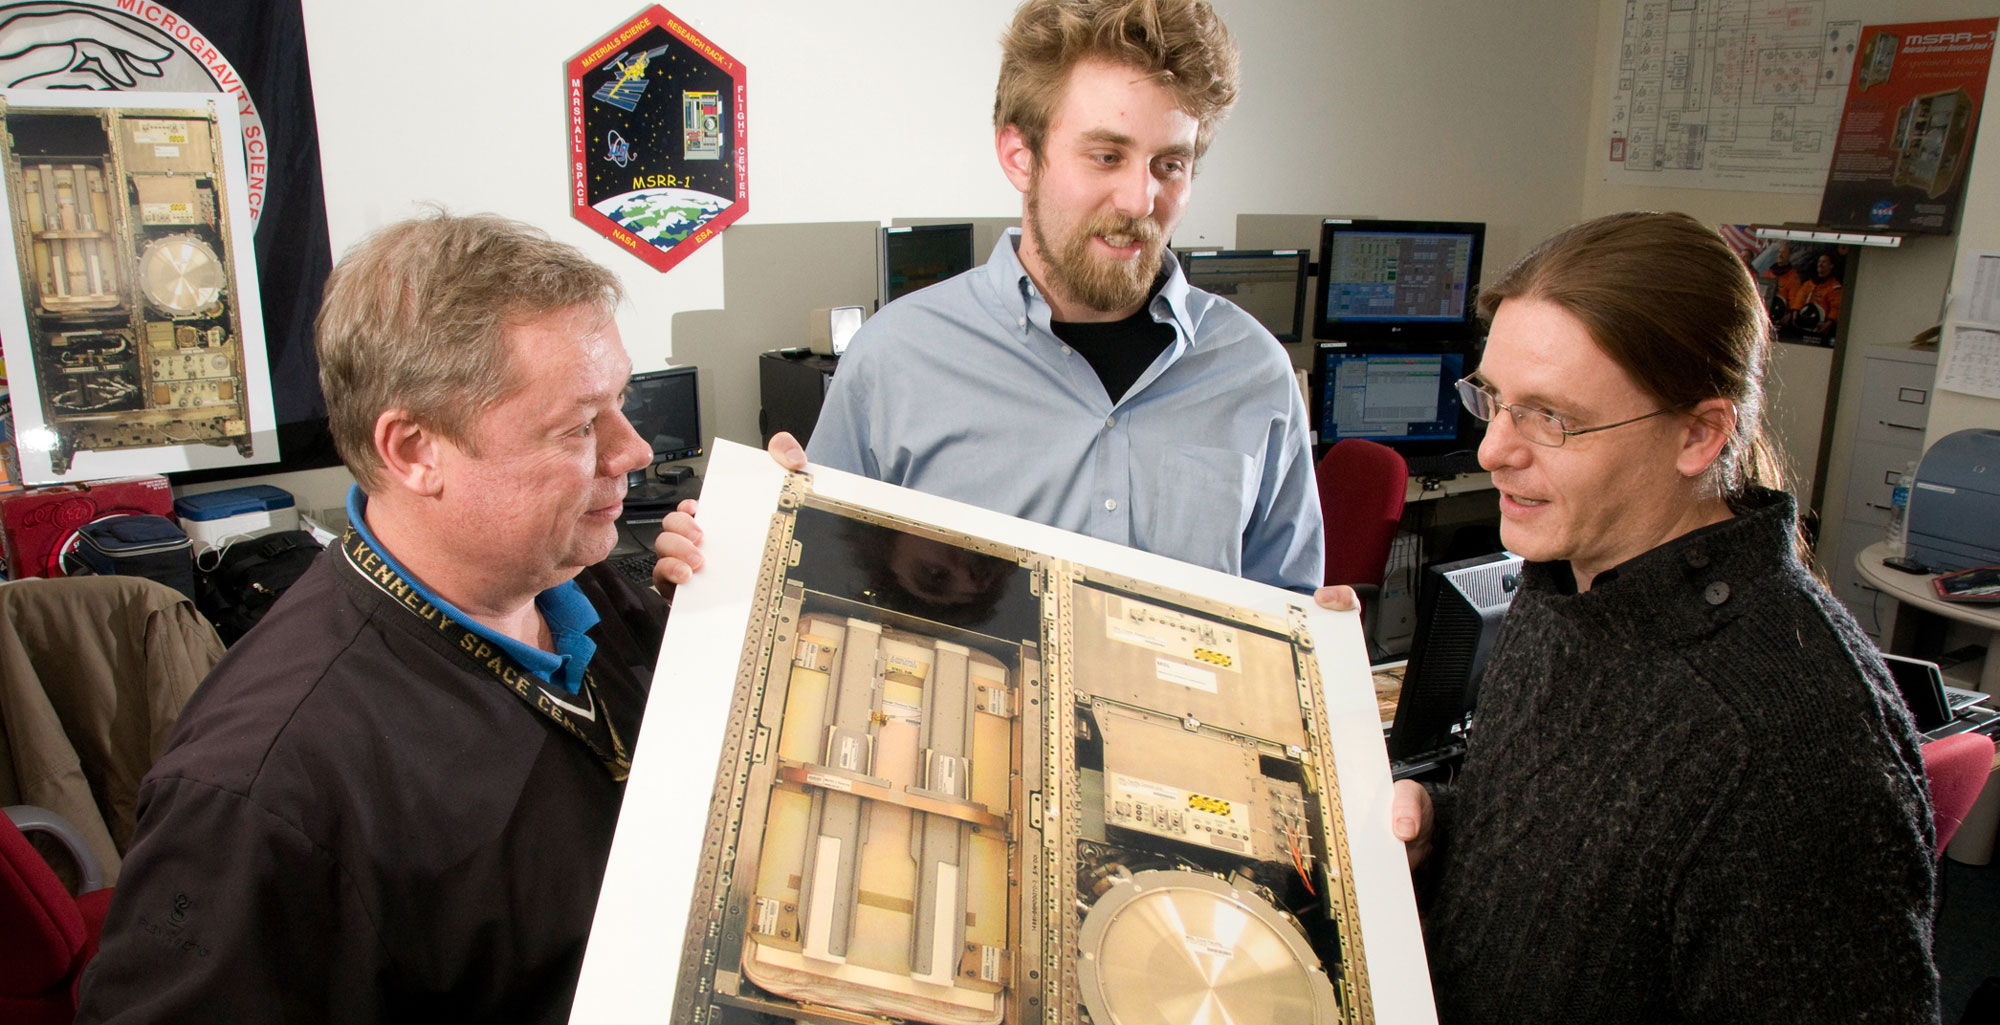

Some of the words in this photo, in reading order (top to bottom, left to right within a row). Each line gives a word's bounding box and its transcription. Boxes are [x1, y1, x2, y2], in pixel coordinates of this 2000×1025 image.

[117, 0, 254, 117] MICROGRAVITY
[582, 38, 622, 68] MATERIALS
[619, 18, 651, 45] SCIENCE
[667, 19, 705, 50] RESEARCH
[703, 42, 724, 65] RACK
[1905, 30, 1997, 46] MSRR-1
[571, 79, 582, 153] MARSHALL
[737, 85, 745, 138] FLIGHT
[576, 162, 584, 206] SPACE
[632, 174, 691, 190] MSRR-1
[738, 147, 746, 199] CENTER
[612, 229, 637, 249] NASA
[695, 228, 713, 244] ESA
[353, 541, 455, 631] KENNEDY
[459, 632, 531, 697] SPACE
[537, 694, 597, 747] CENT
